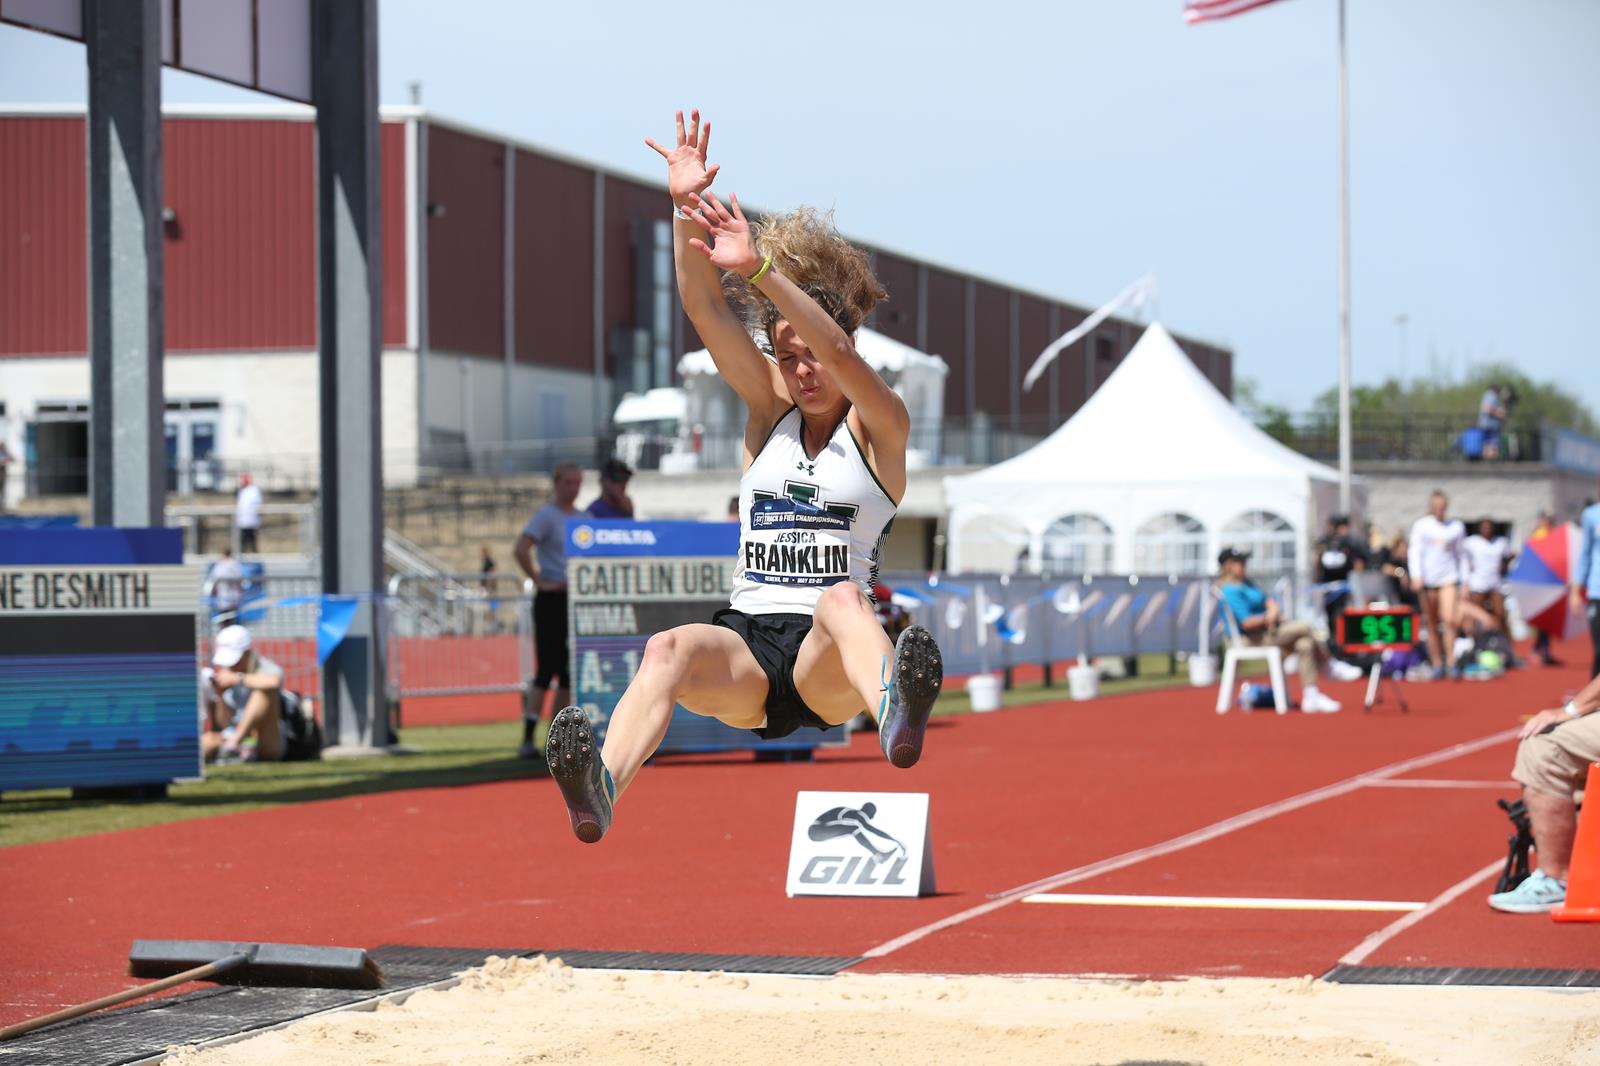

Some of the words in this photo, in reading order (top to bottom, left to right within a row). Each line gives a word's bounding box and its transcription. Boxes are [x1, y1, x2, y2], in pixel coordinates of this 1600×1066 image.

[764, 514, 779, 523] TRACK
[795, 514, 845, 526] CHAMPIONSHIPS
[595, 529, 656, 545] DELTA
[774, 532, 817, 544] JESSICA
[745, 541, 849, 574] FRANKLIN
[34, 572, 150, 609] DESMITH
[577, 564, 673, 595] CAITLIN
[799, 855, 909, 885] GILL
